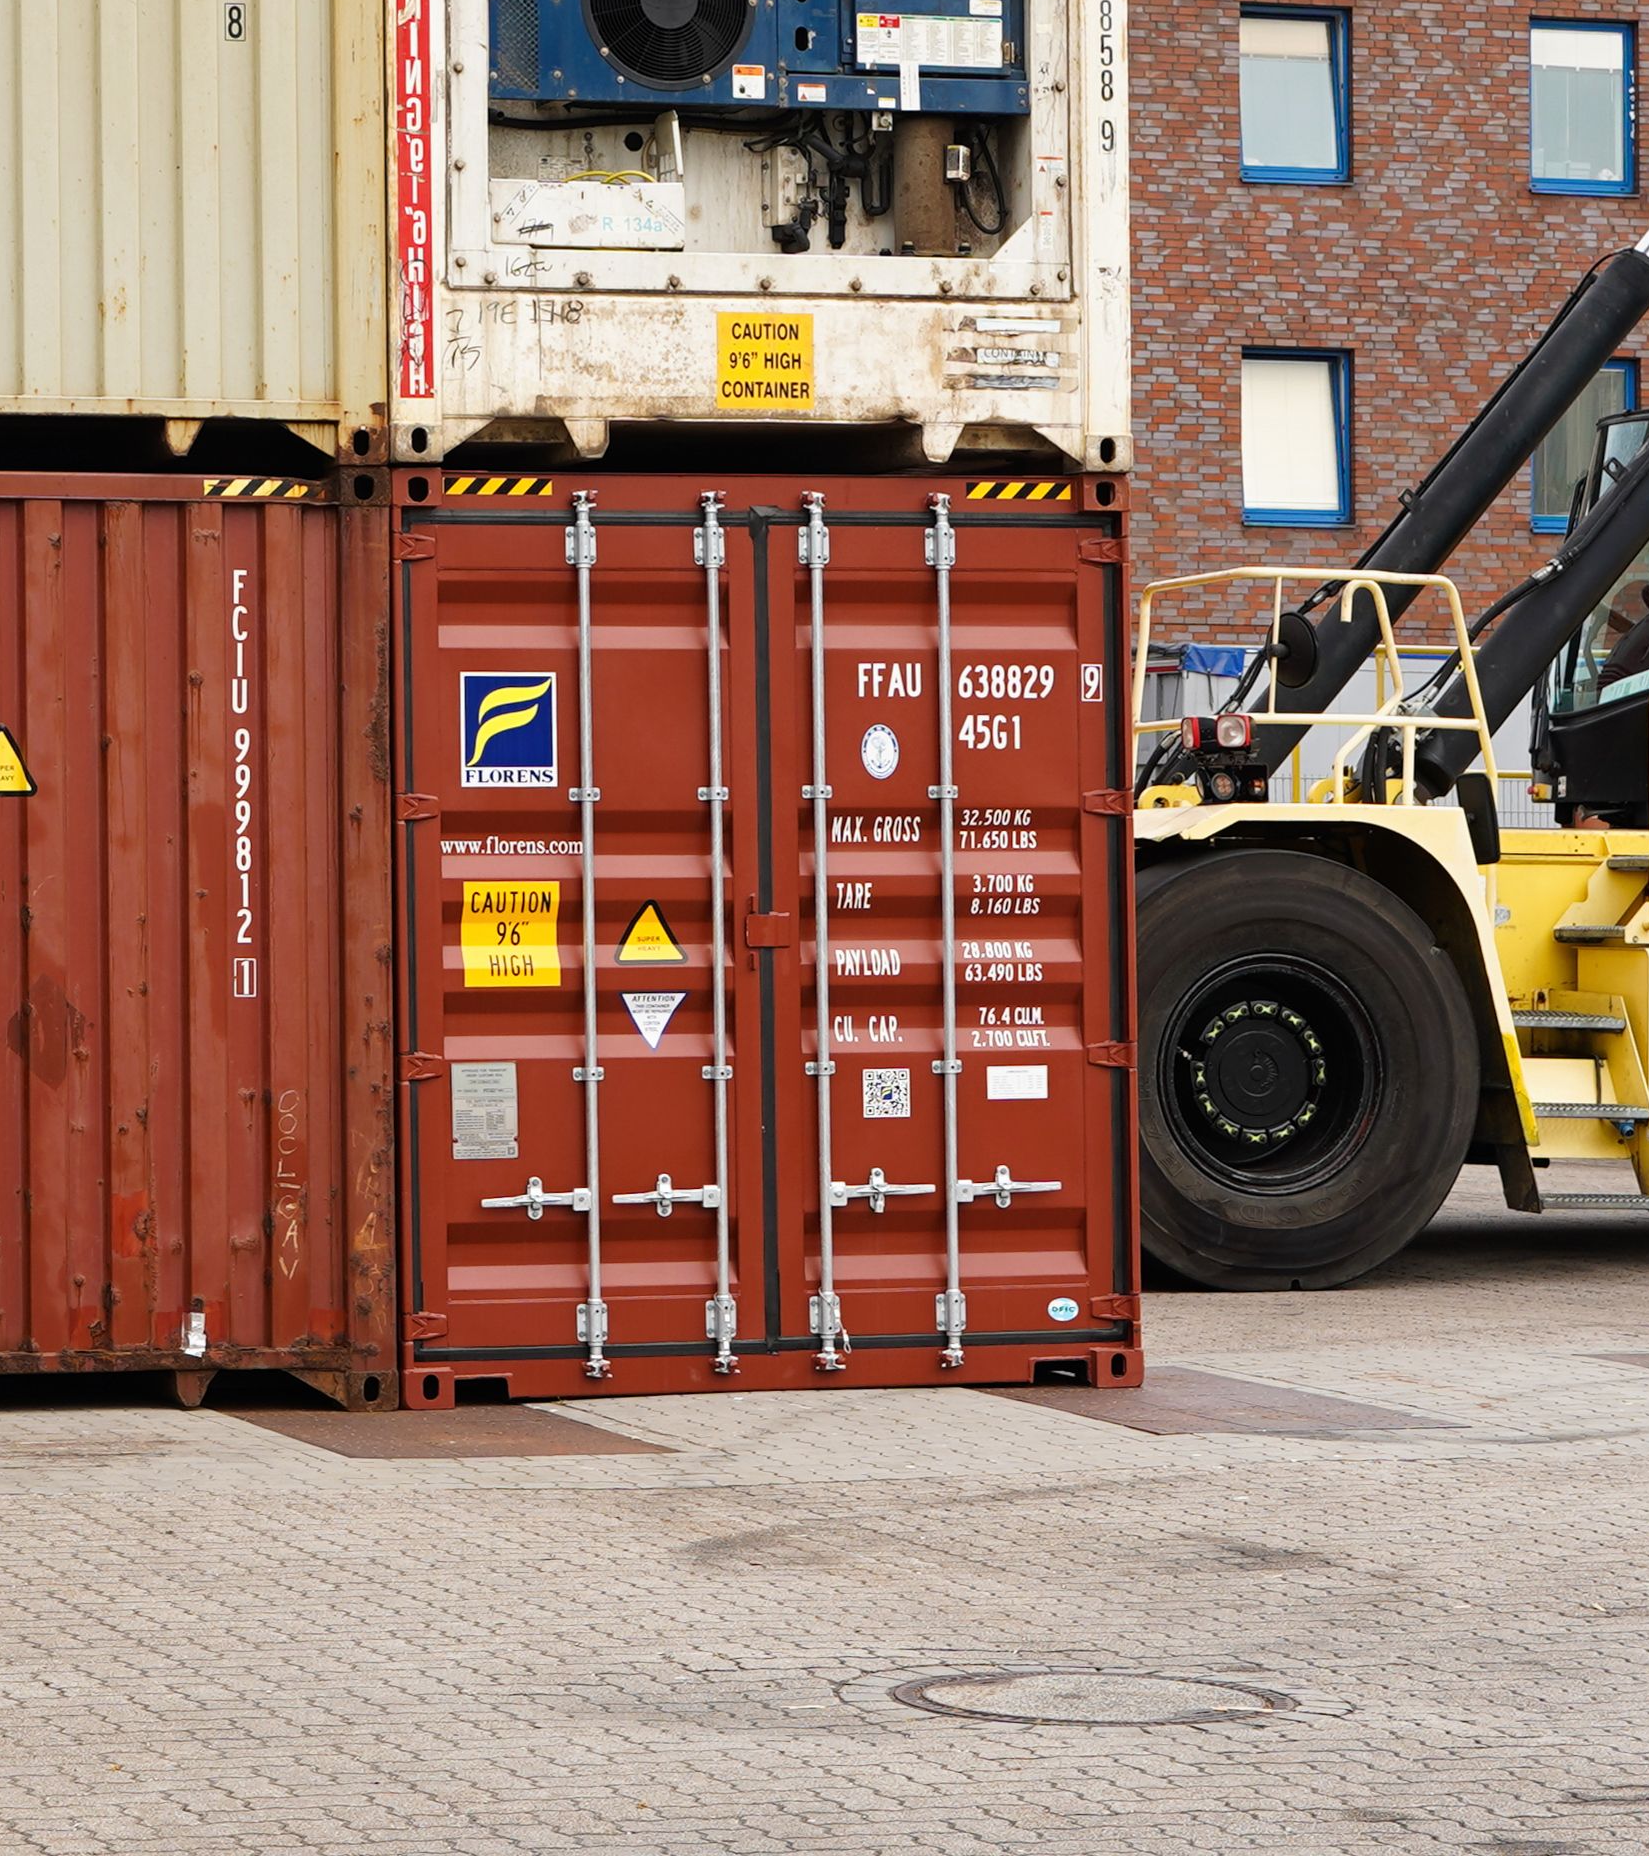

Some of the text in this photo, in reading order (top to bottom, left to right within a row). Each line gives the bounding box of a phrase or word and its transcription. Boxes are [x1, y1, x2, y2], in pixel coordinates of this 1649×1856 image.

[1100, 118, 1115, 153] 9
[731, 322, 800, 342] CAUTION
[764, 352, 802, 372] HIGH
[721, 380, 811, 401] CONTAINER
[230, 569, 249, 715] FCIU
[858, 663, 1101, 701] FFAU 638829 9
[959, 714, 1022, 750] 45G1
[465, 769, 554, 784] FLORENS
[1014, 809, 1032, 826] KG
[234, 729, 253, 944] 999812
[832, 815, 921, 843] MAX. GROSS
[1011, 830, 1037, 849] LBS
[440, 836, 584, 855] www.florens.com
[1016, 874, 1034, 892] KG
[470, 890, 552, 914] CAUTION
[836, 882, 872, 910] TARE
[1016, 897, 1040, 914] LBS
[1014, 941, 1033, 959] KG
[490, 954, 535, 977] HIGH
[836, 948, 901, 977] PAYLOAD
[1018, 963, 1043, 982] LBS
[631, 995, 676, 1003] ATTENTION
[834, 1015, 903, 1043] CU. CAP.
